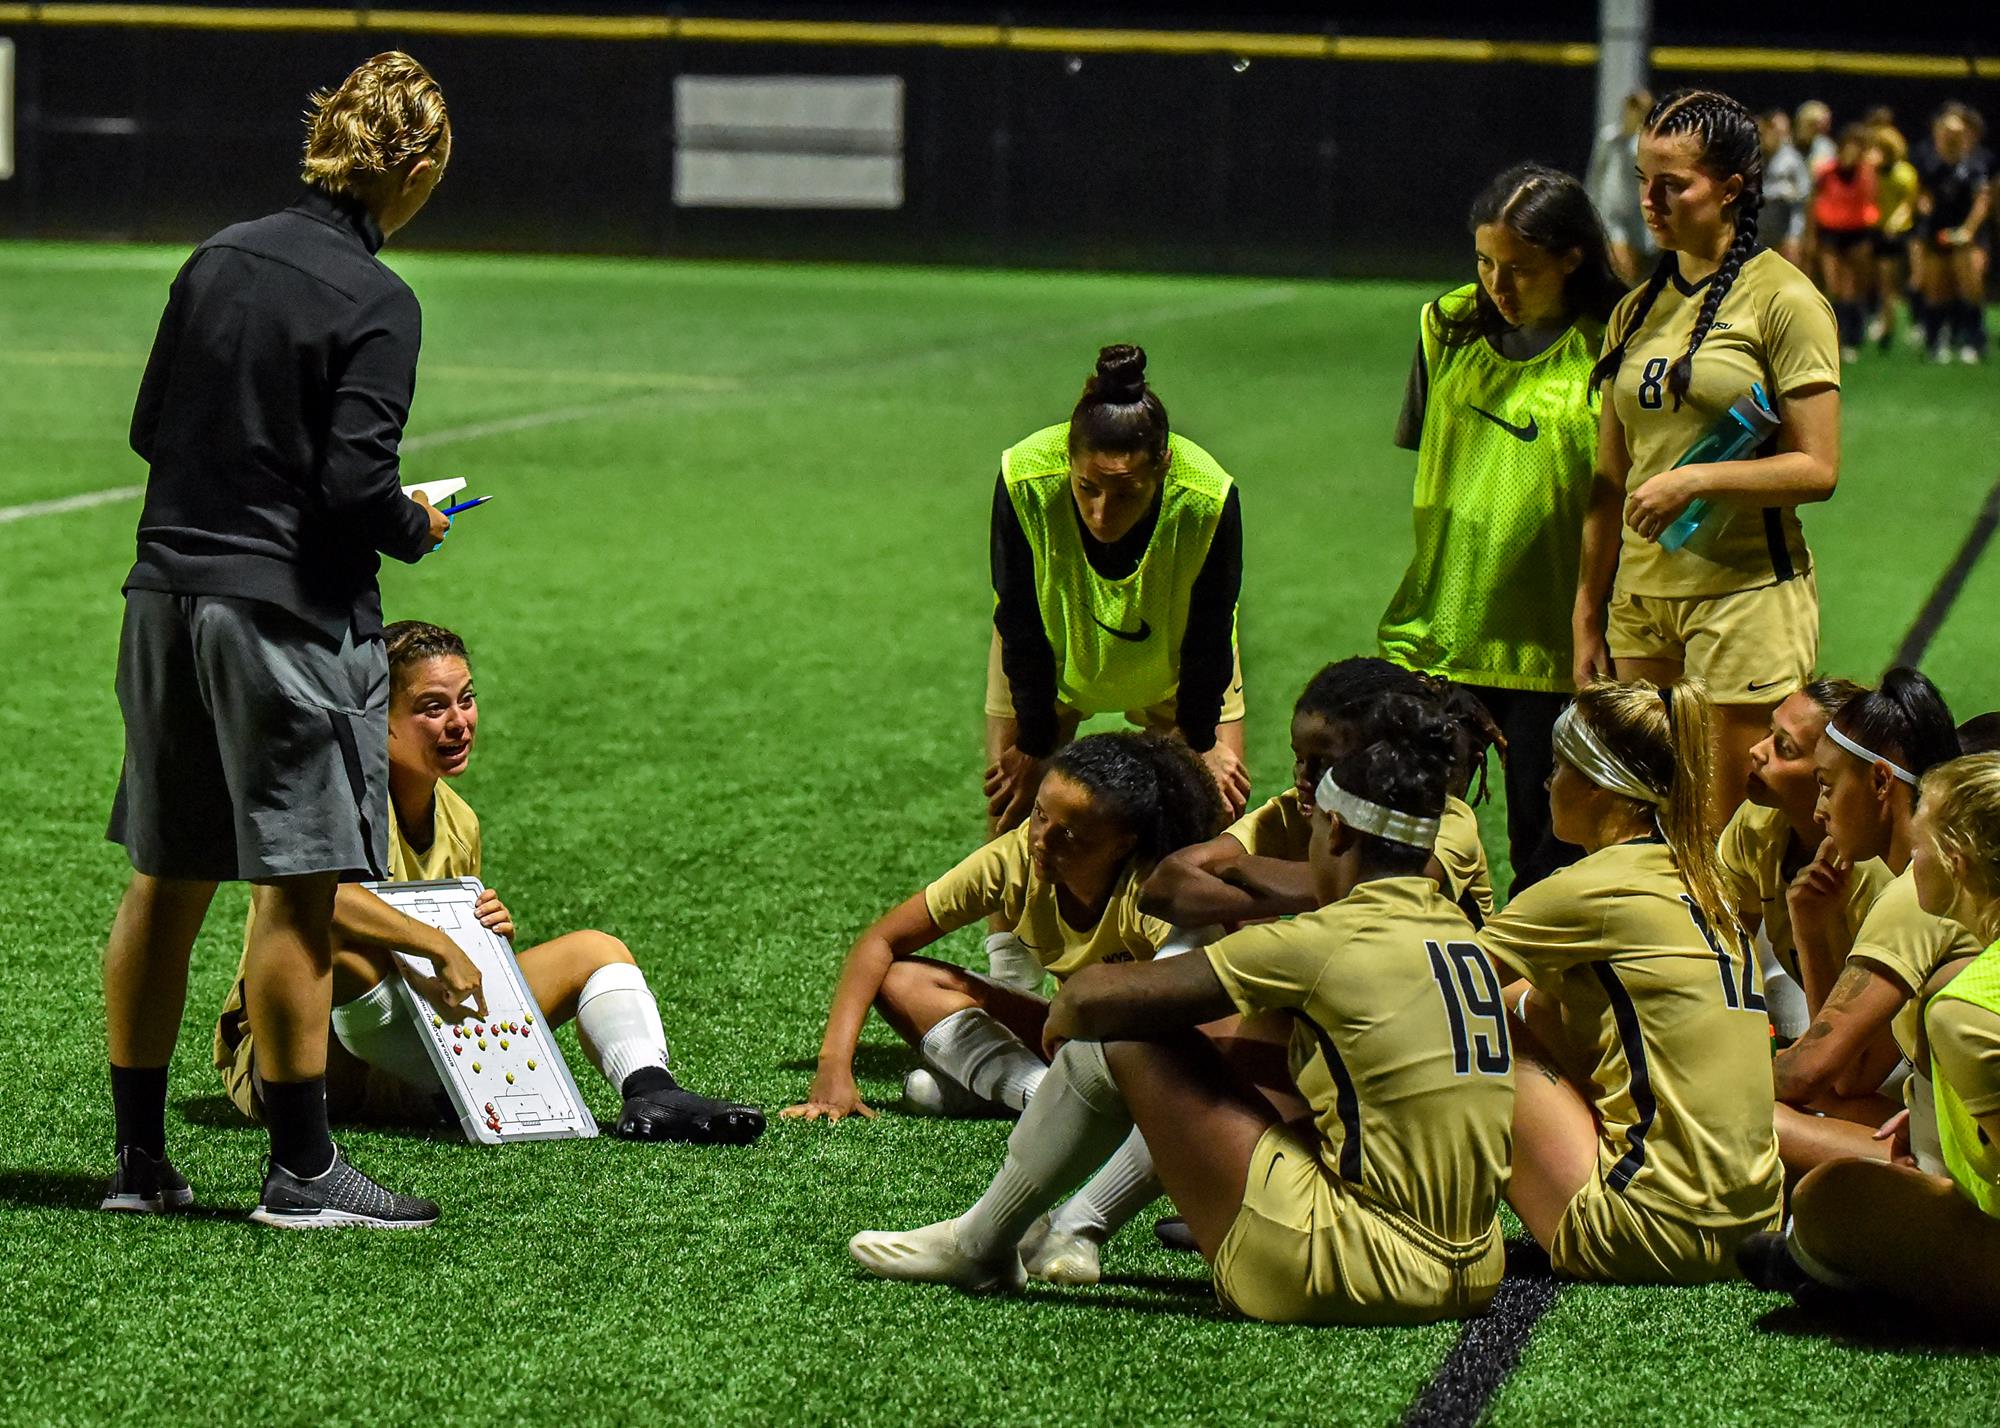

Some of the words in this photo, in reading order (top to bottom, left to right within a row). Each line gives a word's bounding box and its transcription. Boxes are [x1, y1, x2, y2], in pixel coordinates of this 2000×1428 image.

[1710, 321, 1733, 330] VSU
[1638, 357, 1669, 410] 8
[1424, 939, 1512, 1076] 19
